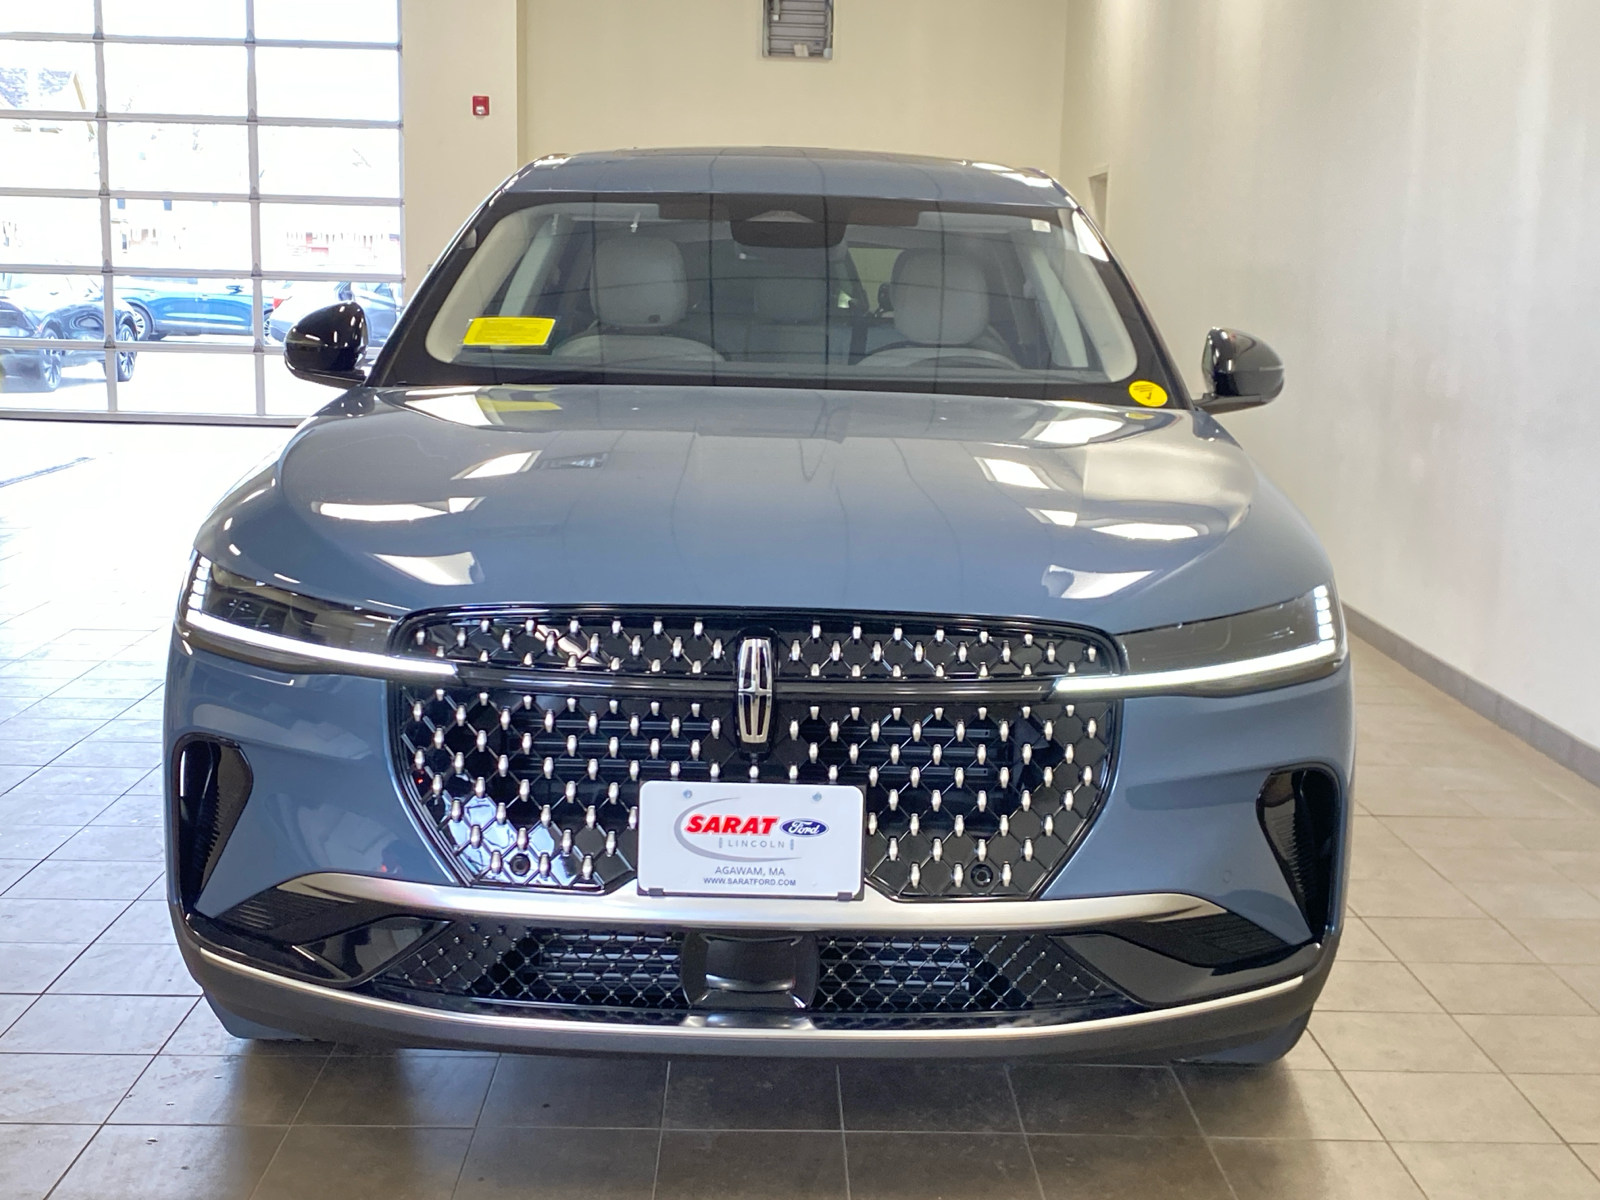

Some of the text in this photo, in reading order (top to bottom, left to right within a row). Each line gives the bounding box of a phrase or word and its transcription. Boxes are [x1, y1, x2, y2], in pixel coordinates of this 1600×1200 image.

[685, 814, 820, 835] SARAT Ford
[728, 839, 785, 849] LINCOLN
[715, 866, 785, 876] AGAWAM, MA
[703, 877, 796, 886] WWW.SARATFORD.COM
